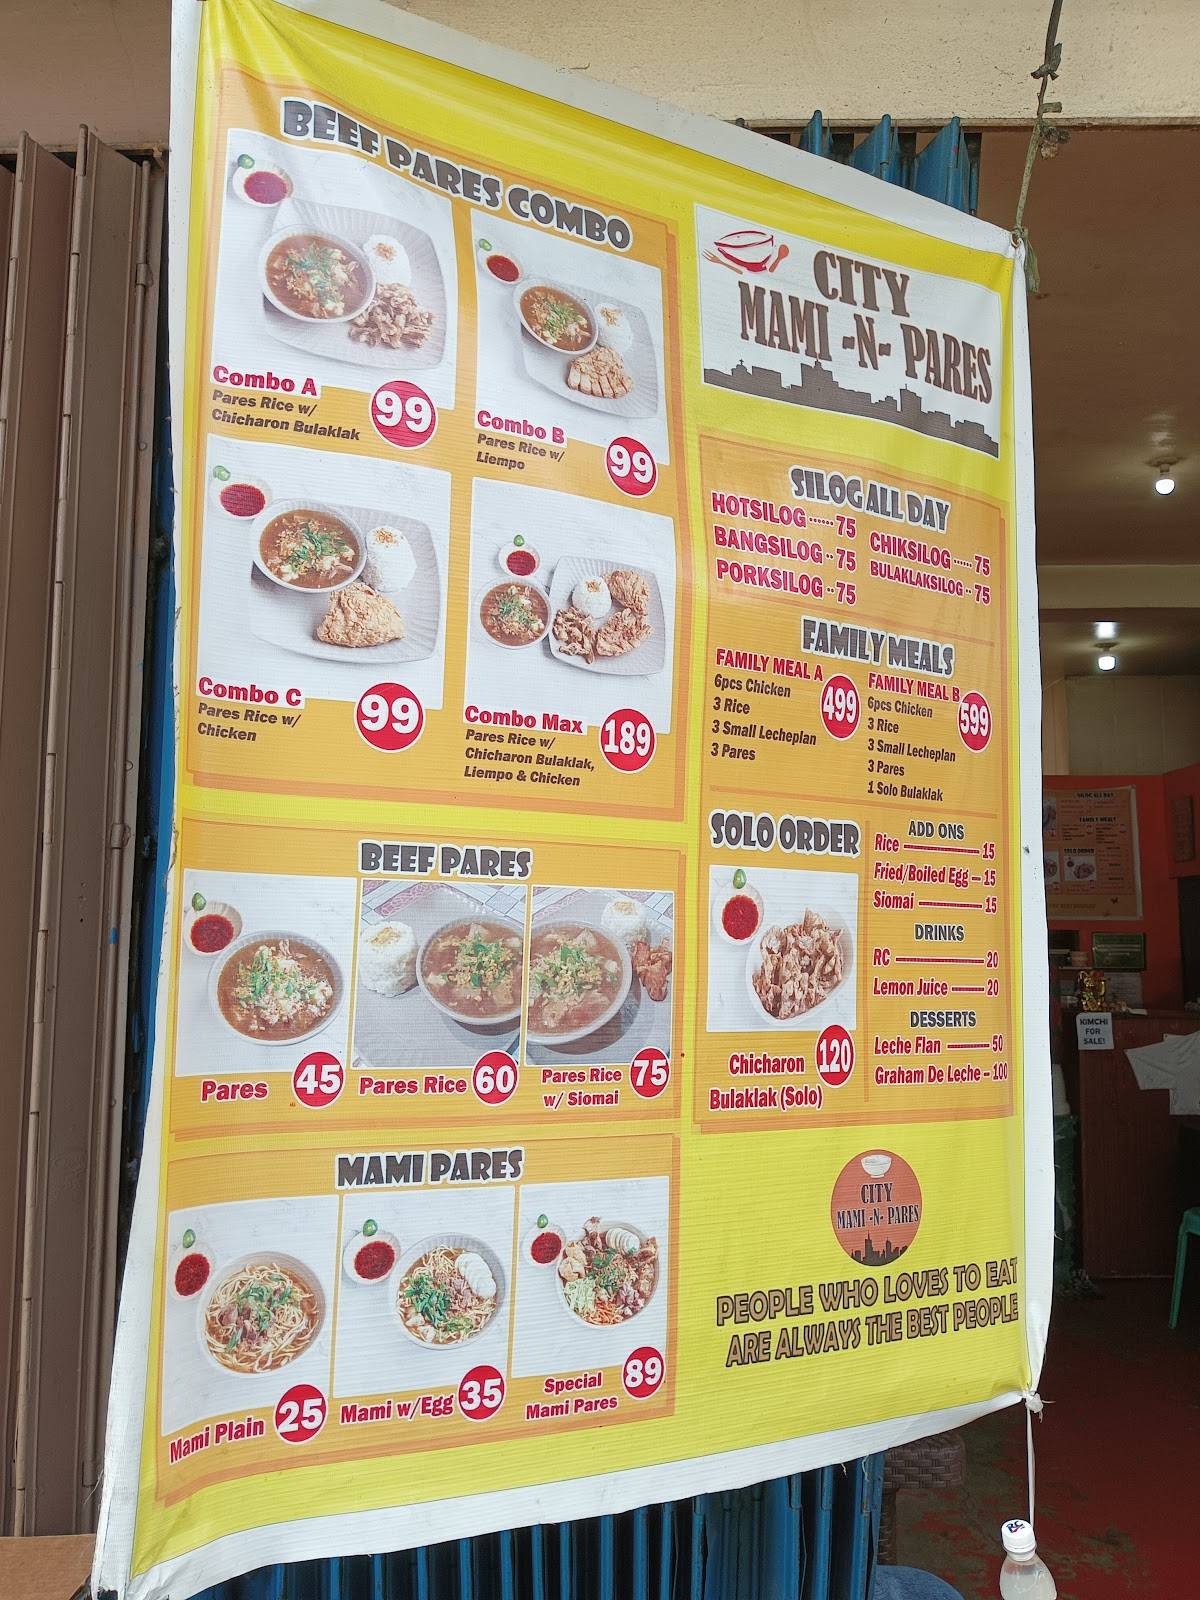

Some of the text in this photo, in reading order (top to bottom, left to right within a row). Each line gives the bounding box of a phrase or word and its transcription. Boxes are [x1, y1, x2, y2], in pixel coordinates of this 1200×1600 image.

[283, 100, 632, 249] BEEF PARES COMBO
[813, 250, 910, 318] CITY
[738, 280, 833, 362] MAMI
[900, 322, 993, 404] PARES
[213, 366, 318, 396] Combo A
[213, 390, 316, 417] Pares Rice w/
[373, 391, 433, 428] 99
[212, 409, 360, 440] Chicharon Bulaklak
[478, 411, 565, 443] Combo B
[477, 452, 525, 470] Liempo
[478, 434, 565, 462] Pares Rice w/
[610, 447, 652, 482] 99
[791, 468, 950, 531] SILOG ALL DAY
[712, 492, 856, 538] HOTSILOG 75
[714, 525, 856, 572] BANGSILOG 75
[870, 532, 990, 576] CHIKSILOG 75
[716, 559, 856, 605] PORKSILOG 75
[870, 561, 990, 604] BULAKLAKSILOG 75
[802, 618, 953, 676] FAMILY MEALS
[716, 649, 823, 681] FAMILY MEAL A
[199, 677, 301, 706] Combo C
[714, 674, 791, 698] 6pcs Chicken
[869, 672, 960, 702] FAMILY MEAL B
[198, 704, 301, 727] Pares Rice w/
[360, 699, 419, 733] 99
[713, 697, 750, 714] 3 Rice
[823, 687, 856, 723] 499
[868, 697, 933, 718] 6pcs Chicken
[197, 722, 256, 741] Chicken
[465, 706, 583, 733] Combo Max
[712, 720, 816, 746] 3 Small Lecheplan
[868, 718, 899, 733] 3 Rice
[960, 703, 988, 736] 599
[466, 729, 555, 749] Pares Rice w/
[604, 719, 650, 755] 189
[868, 739, 956, 762] 3 Small Lecheplan
[465, 747, 594, 771] Chicharon Bulaklak,
[711, 743, 756, 760] 3 Pares
[464, 766, 581, 786] Liempo & Chicken
[868, 760, 905, 776] 3 Pares
[868, 781, 943, 801] 1 Solo Bulaklak
[711, 813, 859, 855] SOLO ORDER
[909, 820, 964, 840] ADD ONS
[361, 843, 530, 877] BEEF PARES
[875, 834, 995, 860] Rice 15
[874, 863, 996, 888] Fried/Boiled Egg 15
[874, 891, 997, 913] Siomai 15
[915, 925, 964, 941] DRINKS
[874, 949, 998, 968] RC 20
[874, 978, 998, 996] Lemon Juice 20
[910, 1011, 976, 1027] DESSERTS
[819, 1038, 851, 1073] 120
[874, 1035, 1003, 1054] Leche Flan 50
[542, 1068, 622, 1084] Pares Rice
[633, 1059, 668, 1086] 75
[729, 1054, 805, 1075] Chicharon
[875, 1063, 1008, 1084] Graham De Leche 100
[202, 1063, 341, 1101] Pares 45
[360, 1065, 515, 1096] Pares Rice 60
[544, 1091, 618, 1108] w/ Siomai
[710, 1085, 822, 1110] Bulaklak (Solo)
[337, 1149, 523, 1188] MAMI PARES
[861, 1182, 893, 1204] CITY
[837, 1209, 866, 1229] MAMI
[887, 1204, 919, 1224] PARES
[717, 1256, 1018, 1326] PEOPLE WHO LOVES TO EAT
[725, 1293, 1018, 1367] ARE ALWAYS THE BEST PEOPLE
[545, 1373, 601, 1395] Special
[624, 1358, 660, 1388] 89
[341, 1381, 501, 1423] Mami w/Egg 35
[527, 1396, 618, 1420] Mami Pares
[170, 1398, 323, 1463] Mami Plain 25
